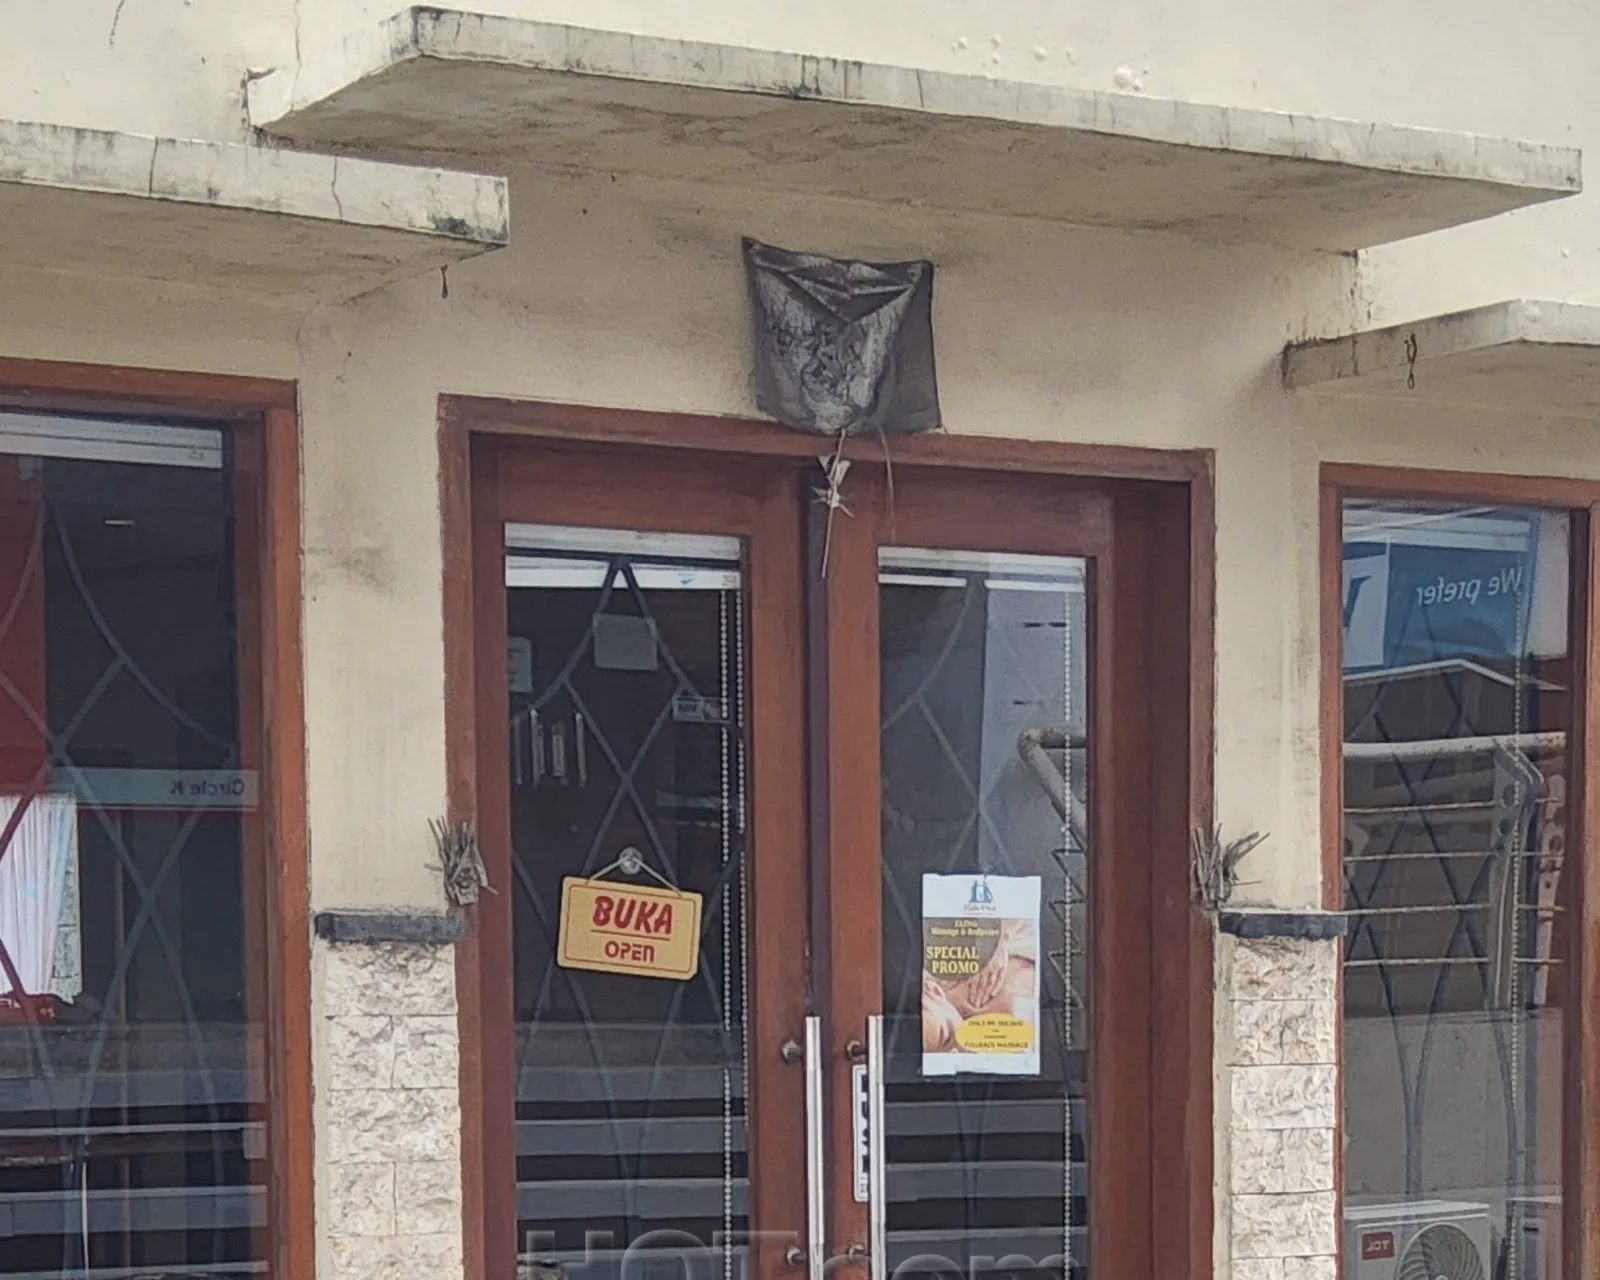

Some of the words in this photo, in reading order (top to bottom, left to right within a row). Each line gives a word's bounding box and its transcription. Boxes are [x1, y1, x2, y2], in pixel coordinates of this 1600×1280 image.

[592, 895, 674, 935] BUKA
[604, 940, 656, 962] OPEN
[926, 946, 979, 959] SPECIAL
[932, 960, 979, 974] PROMO
